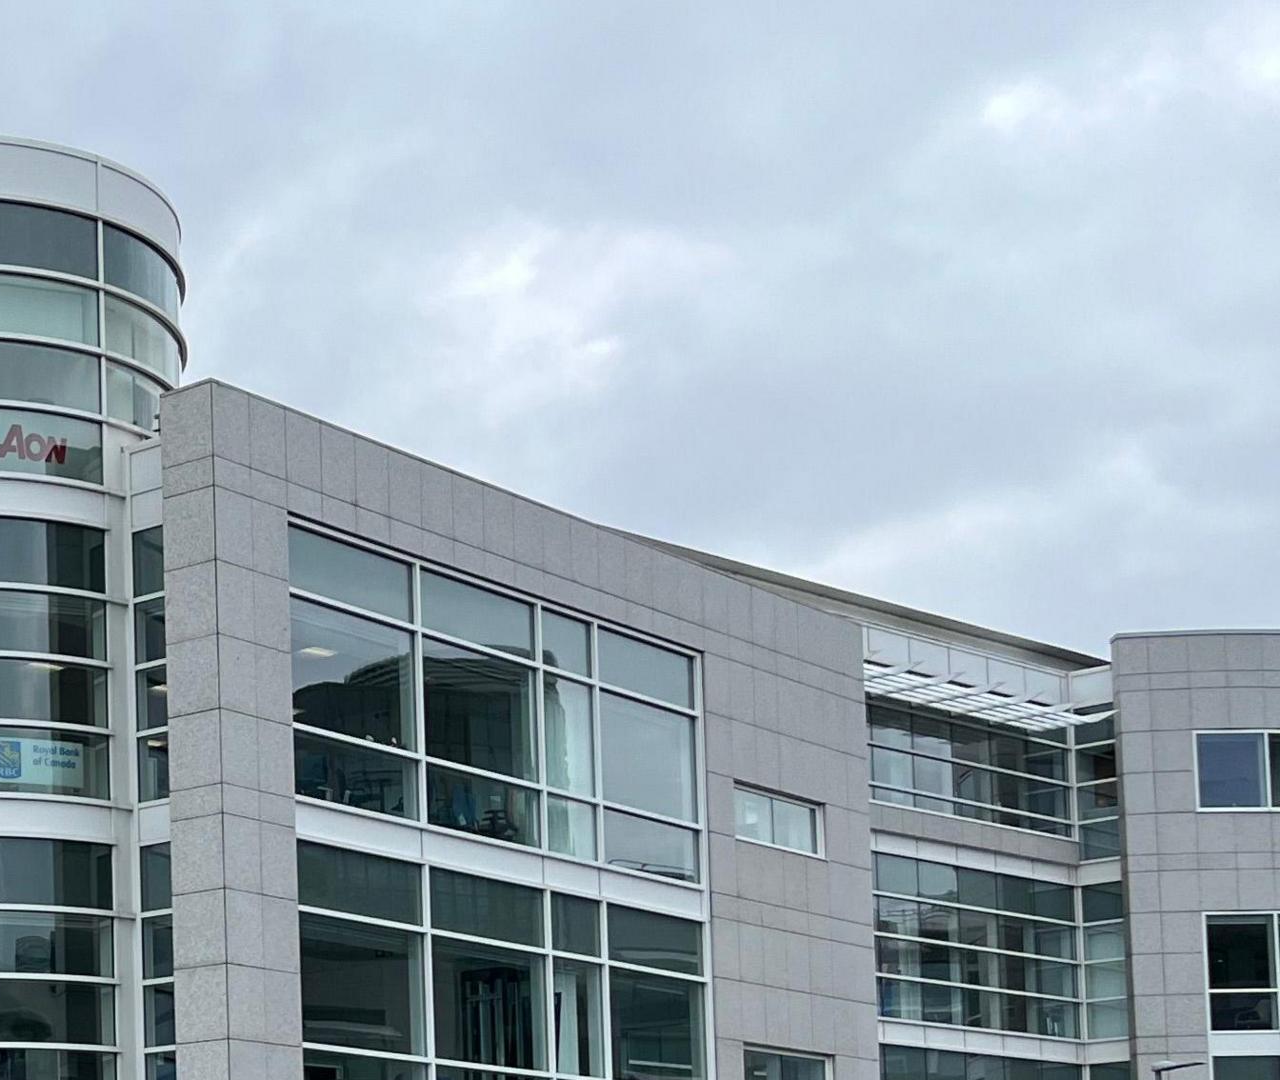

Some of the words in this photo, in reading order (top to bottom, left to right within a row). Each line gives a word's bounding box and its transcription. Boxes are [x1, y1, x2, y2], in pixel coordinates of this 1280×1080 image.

[32, 744, 57, 756] Royal
[59, 746, 80, 757] Bank
[32, 757, 42, 766] of
[44, 758, 76, 769] Canada
